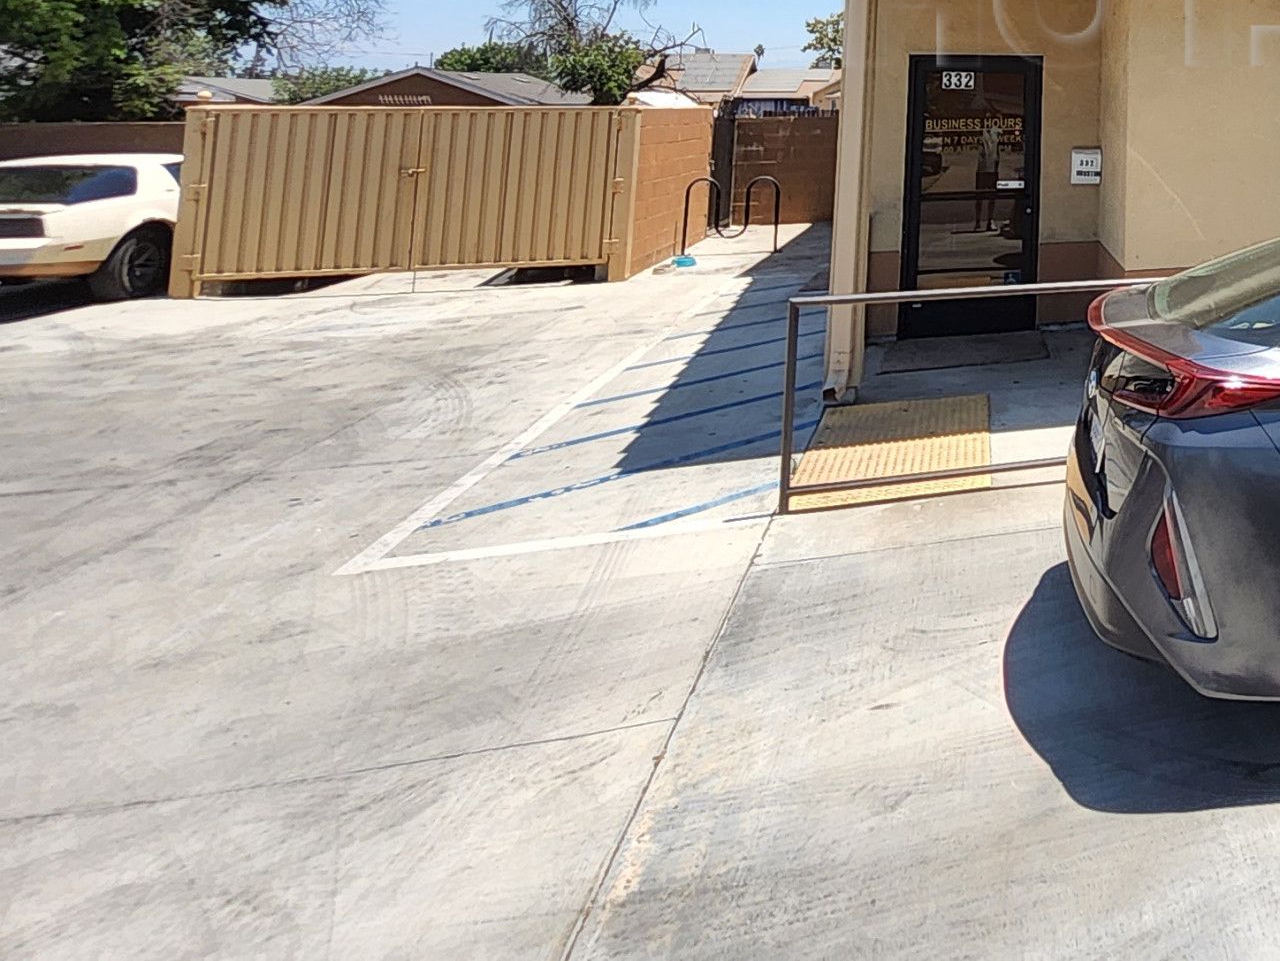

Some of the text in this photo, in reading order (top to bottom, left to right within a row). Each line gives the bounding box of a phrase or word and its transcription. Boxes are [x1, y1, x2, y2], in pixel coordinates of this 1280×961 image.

[943, 72, 973, 89] 332
[925, 117, 1023, 130] BUSINESS HOURS
